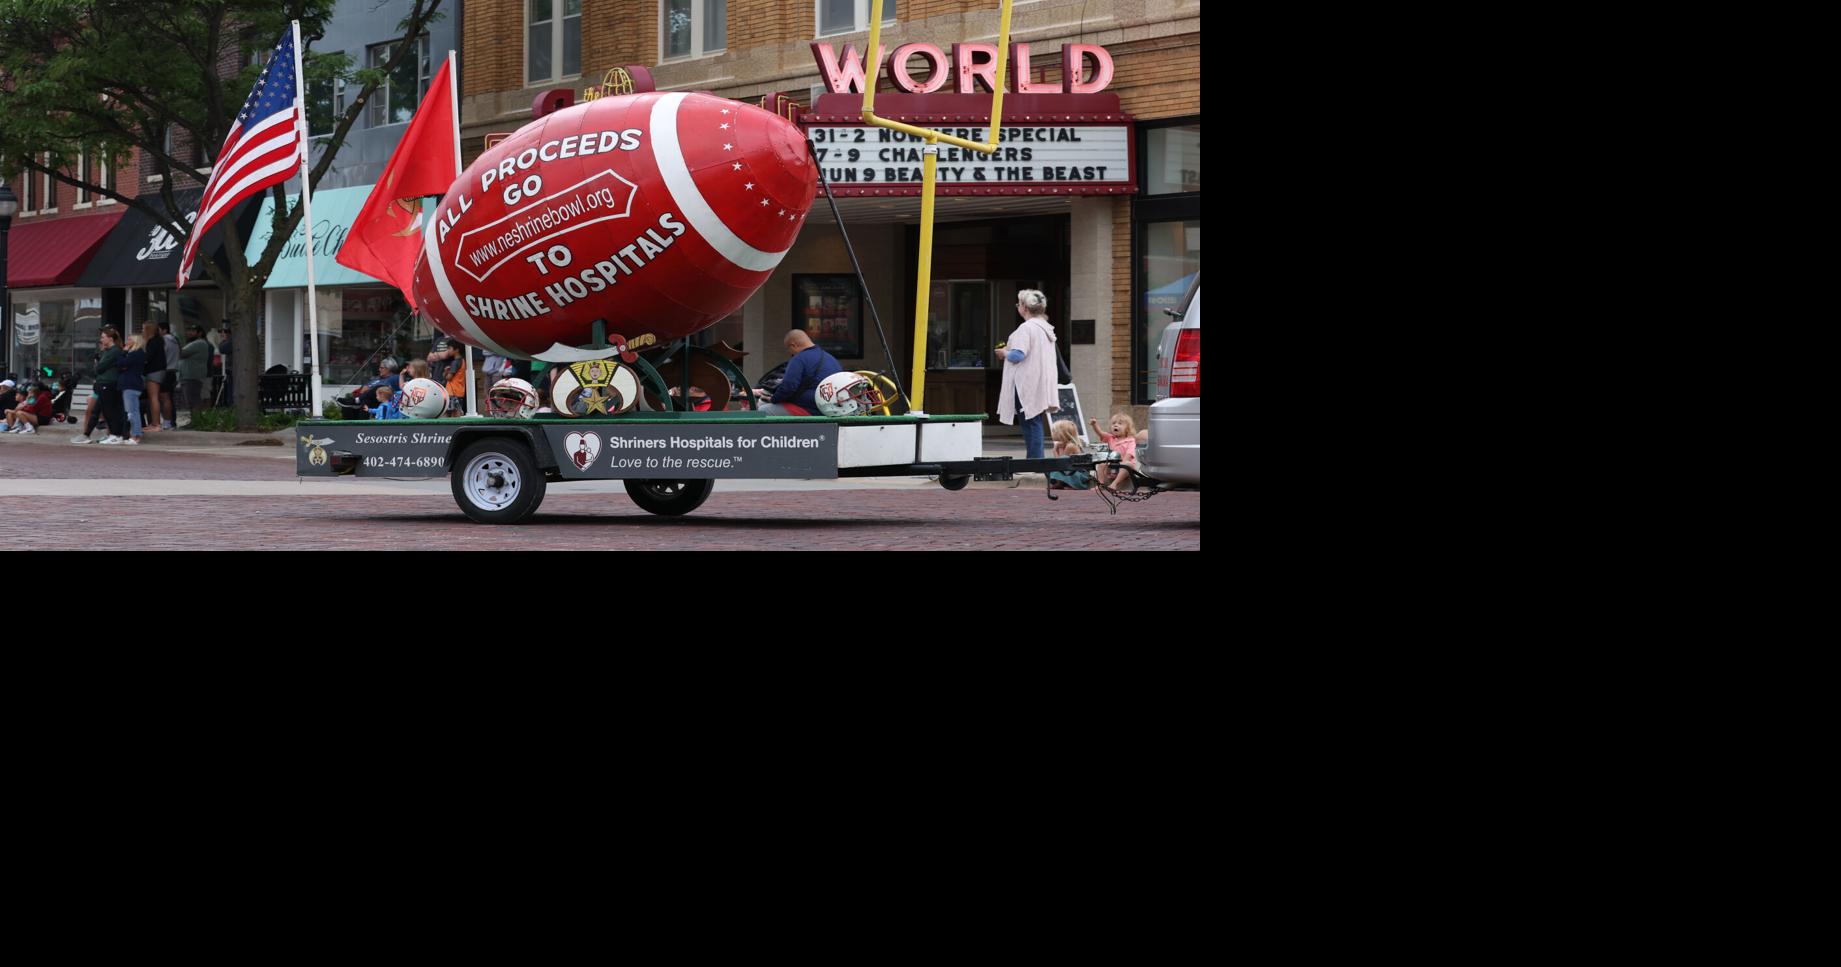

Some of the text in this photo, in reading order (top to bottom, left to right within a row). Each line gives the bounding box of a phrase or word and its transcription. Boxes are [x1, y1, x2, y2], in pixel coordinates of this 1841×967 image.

[809, 42, 1114, 94] WORLD
[998, 127, 1082, 142] SPECIAL
[878, 147, 1033, 163] CHALENGERS
[863, 167, 876, 182] 9
[884, 167, 965, 182] BEATY
[973, 166, 986, 181] &
[994, 166, 1034, 181] THE
[1043, 165, 1108, 181] BEAST
[438, 128, 643, 244] ALL PROCEEDS
[503, 174, 543, 206] GO
[469, 186, 616, 268] www.neshrinebowl.org
[464, 212, 687, 321] SHRINE HOSPITALS
[526, 244, 572, 276] TO
[355, 432, 452, 444] Sesostris Shrine
[609, 435, 667, 448] Shriners
[670, 435, 734, 451] Hospitals
[737, 435, 757, 448] for
[363, 456, 445, 467] 402-474-6890
[610, 455, 642, 468] Love
[646, 455, 659, 468] to
[662, 455, 683, 468] the
